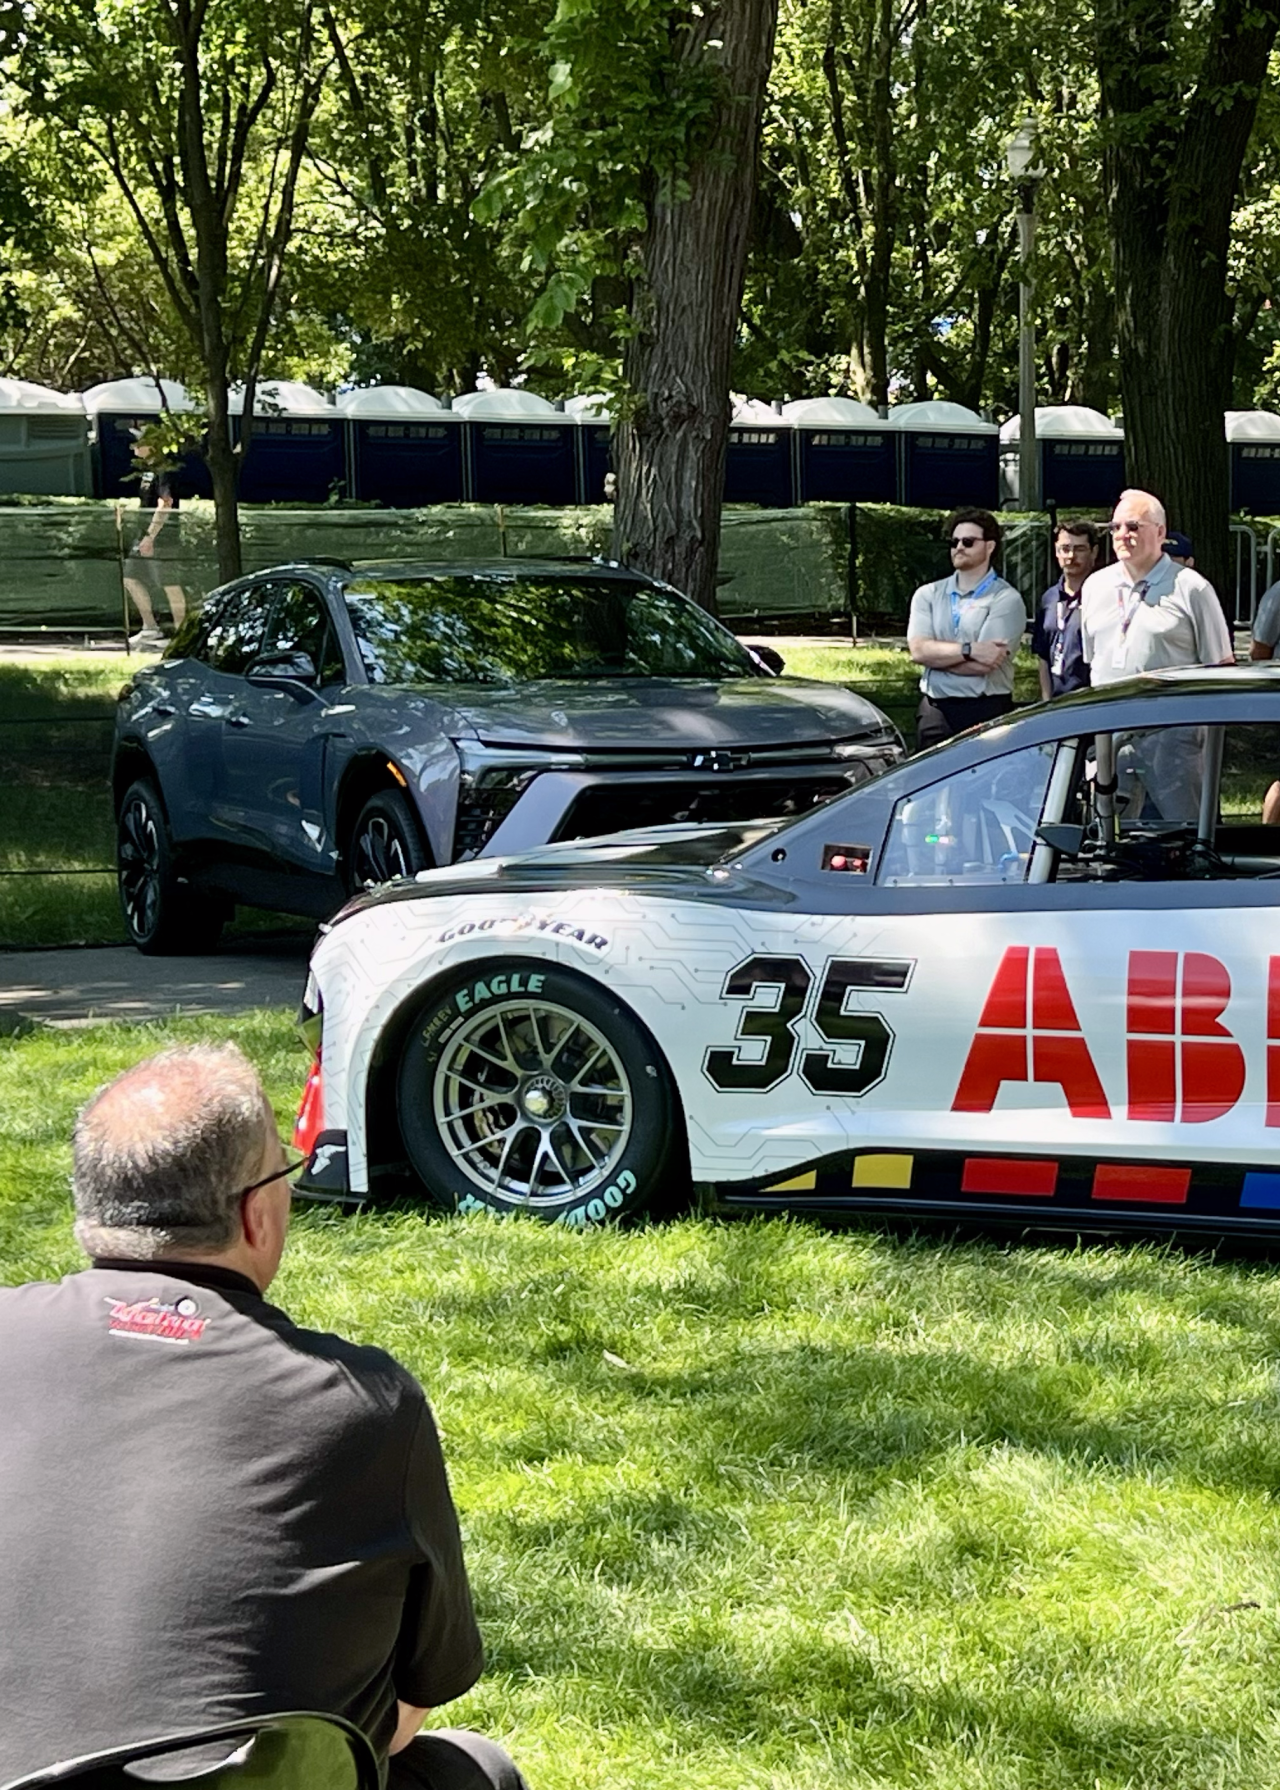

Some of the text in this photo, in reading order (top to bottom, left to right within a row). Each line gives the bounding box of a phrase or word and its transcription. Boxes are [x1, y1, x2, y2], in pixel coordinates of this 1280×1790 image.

[436, 917, 609, 950] GOOYEAR
[454, 973, 547, 1013] EAGLE
[701, 952, 918, 1098] 35
